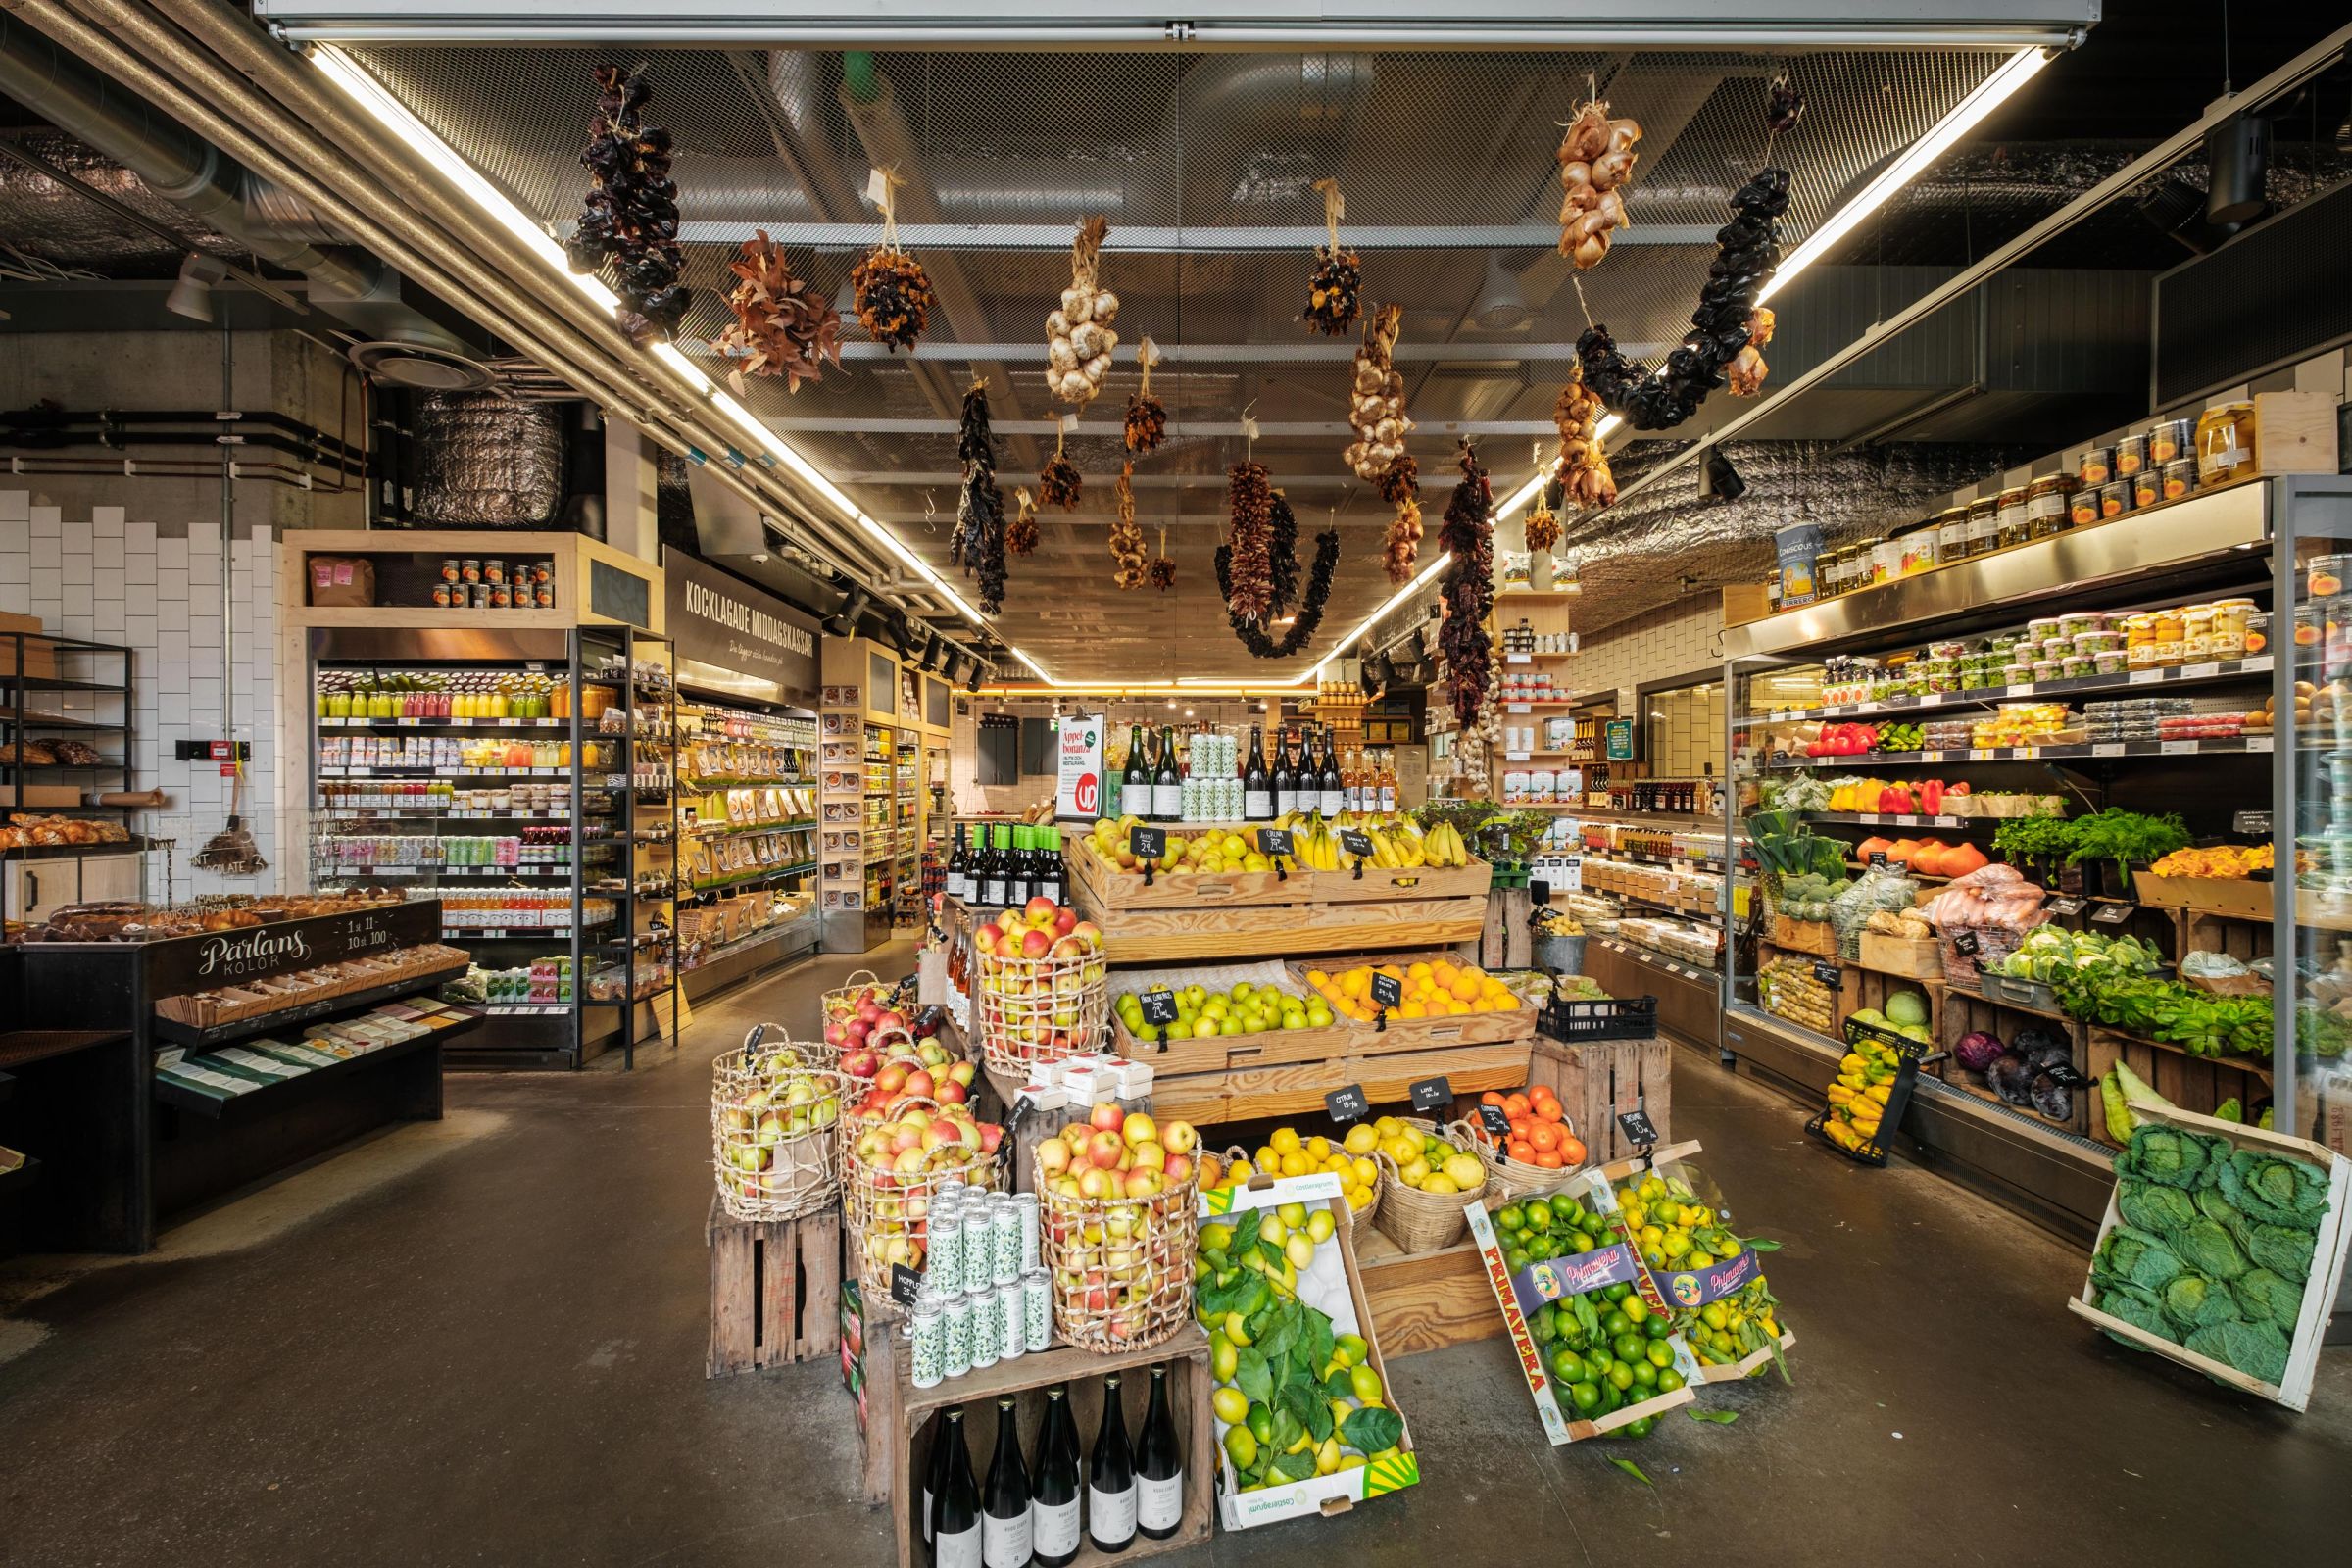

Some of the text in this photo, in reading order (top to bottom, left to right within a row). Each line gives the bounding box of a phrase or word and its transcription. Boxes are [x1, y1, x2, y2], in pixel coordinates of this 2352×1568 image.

[686, 580, 813, 659] KOCKLAGADE MIDDAGSKASSAR
[1063, 728, 1084, 744] Äppel-
[1063, 744, 1091, 754] bonanza
[199, 930, 312, 975] Pärlans
[223, 955, 280, 976] KOLOR
[1566, 1250, 1620, 1284] Primavera
[1710, 1253, 1751, 1293] Primavera
[1485, 1246, 1546, 1394] PRIMAVERA
